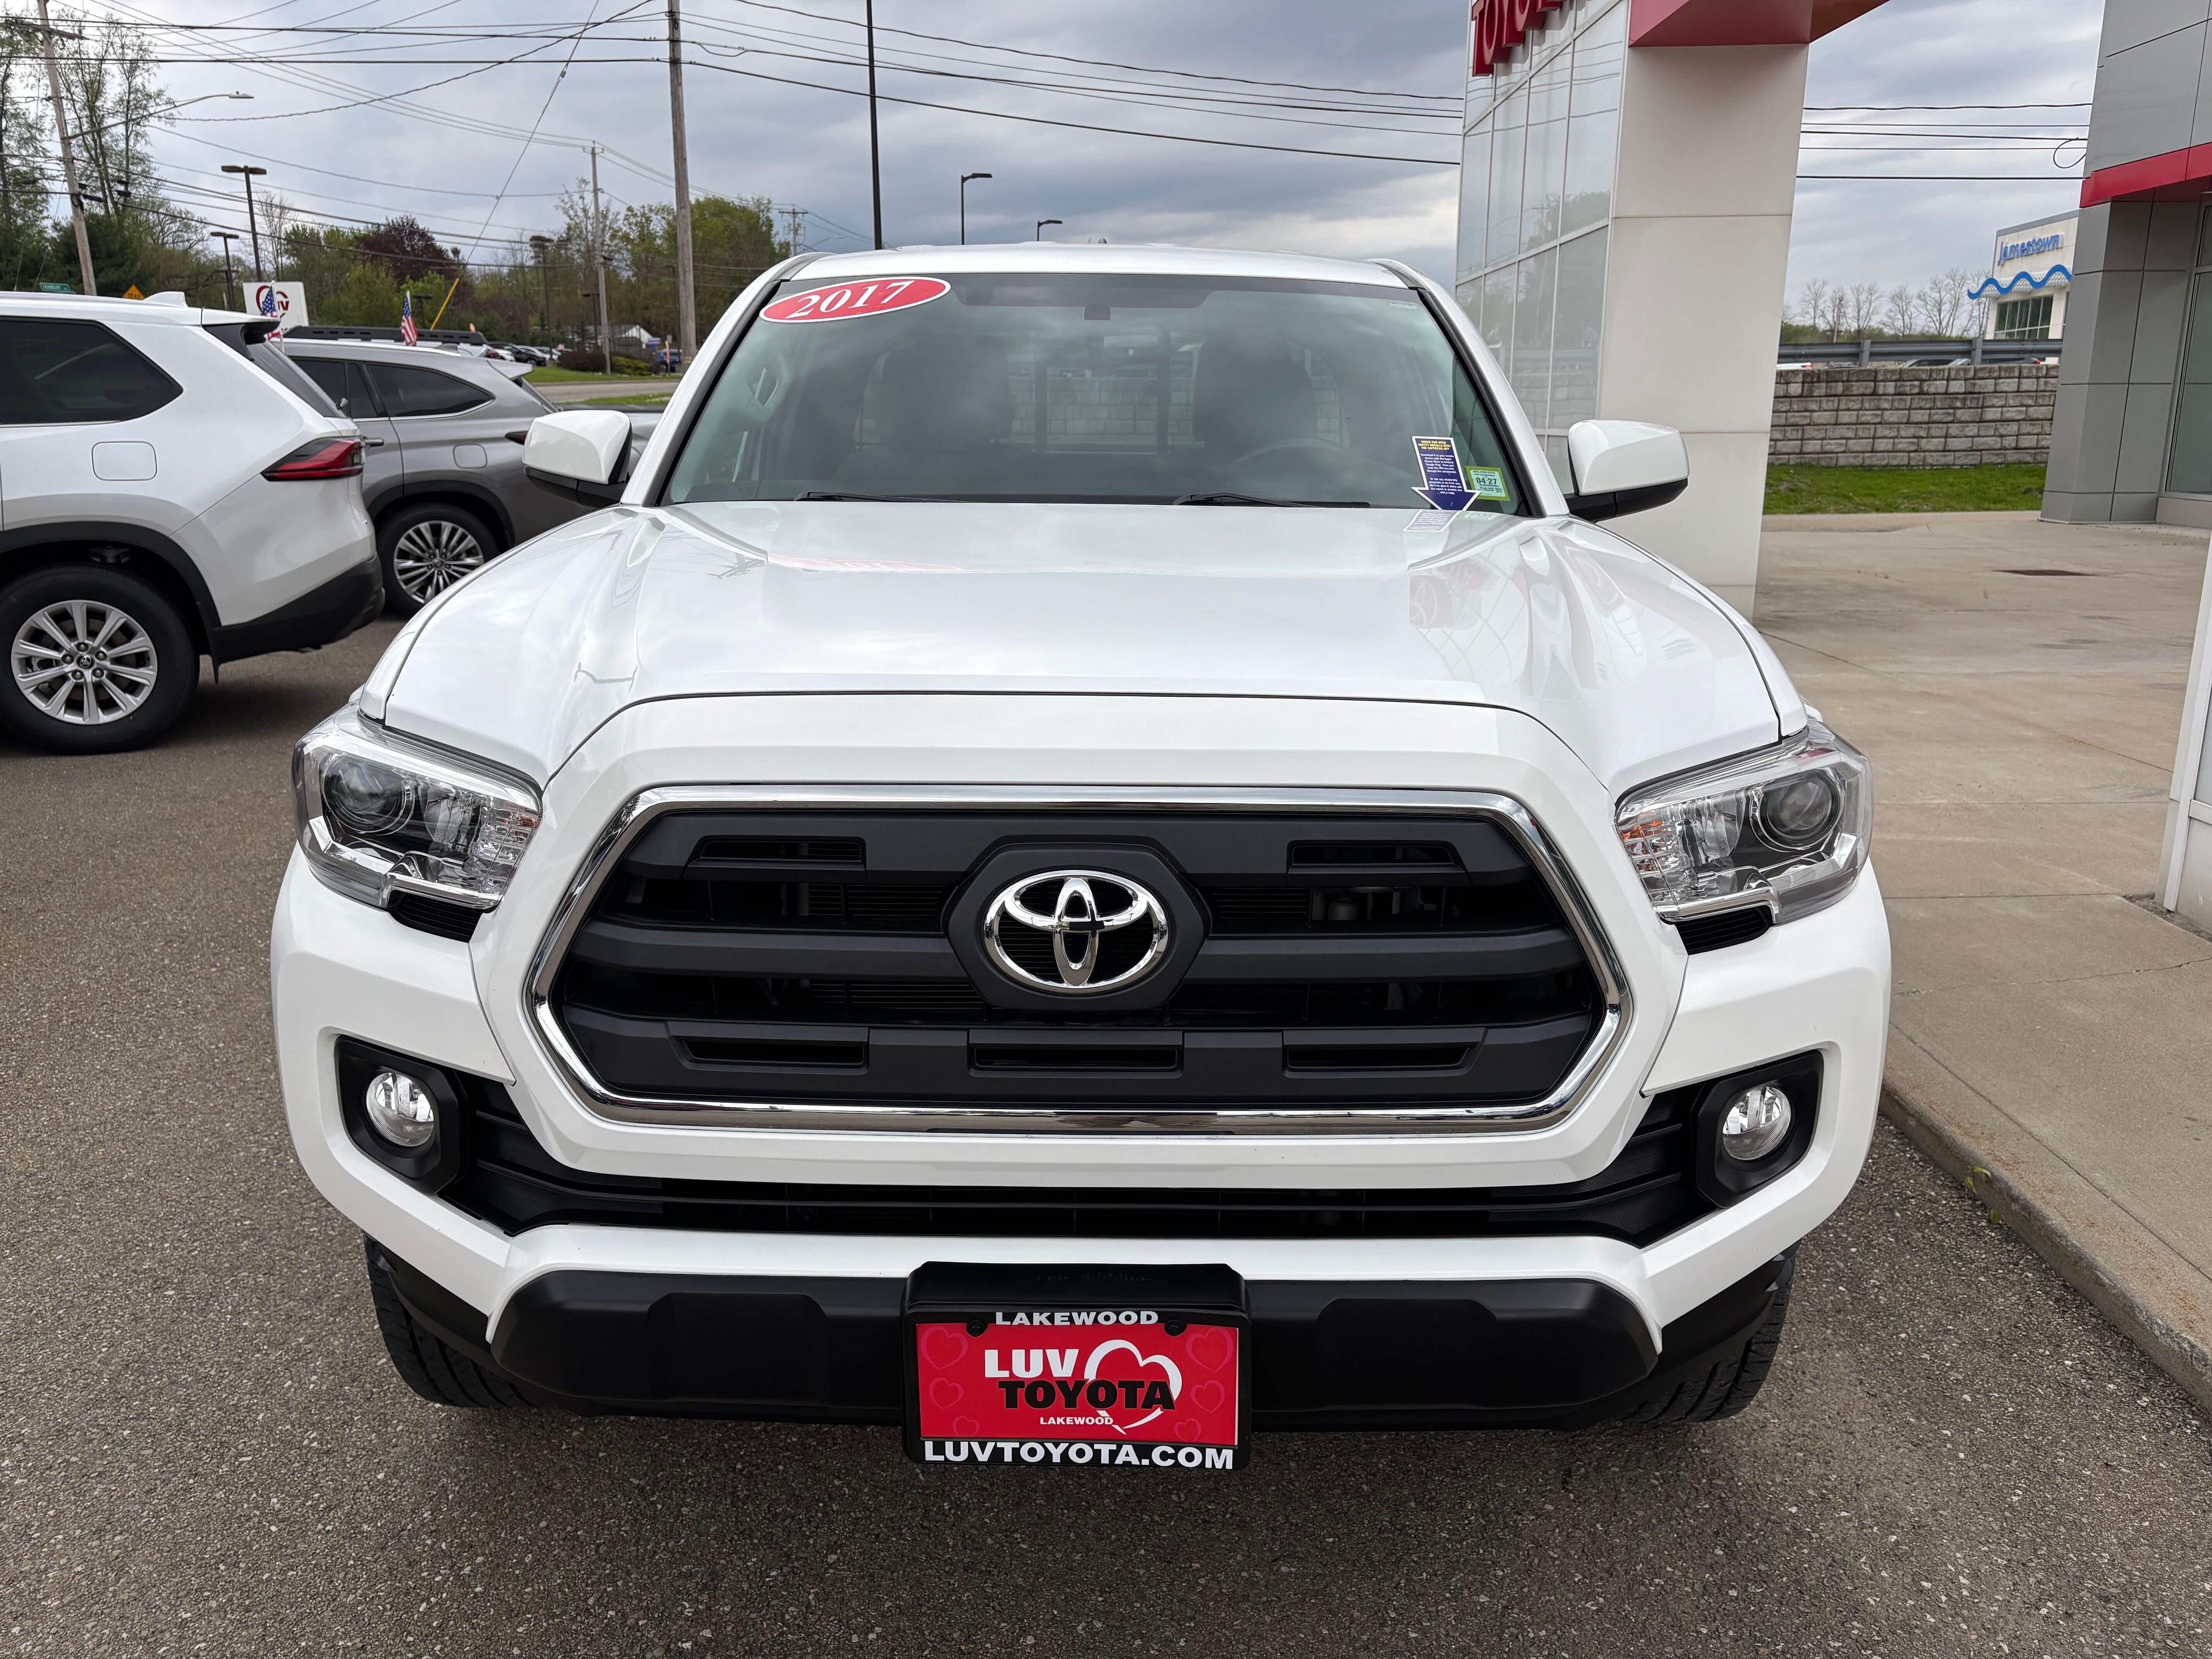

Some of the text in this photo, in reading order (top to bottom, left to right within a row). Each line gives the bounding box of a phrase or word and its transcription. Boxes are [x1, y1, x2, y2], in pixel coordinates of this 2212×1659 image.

[1997, 234, 2060, 266] Jamestown
[785, 280, 915, 319] 2017
[996, 1311, 1158, 1326] LAKEWOOD
[984, 1348, 1079, 1378] LUV
[998, 1380, 1176, 1410] TOYOTA
[1040, 1416, 1113, 1425] LAKEWOOD
[924, 1441, 1233, 1470] LUVTOYOTA.COM
